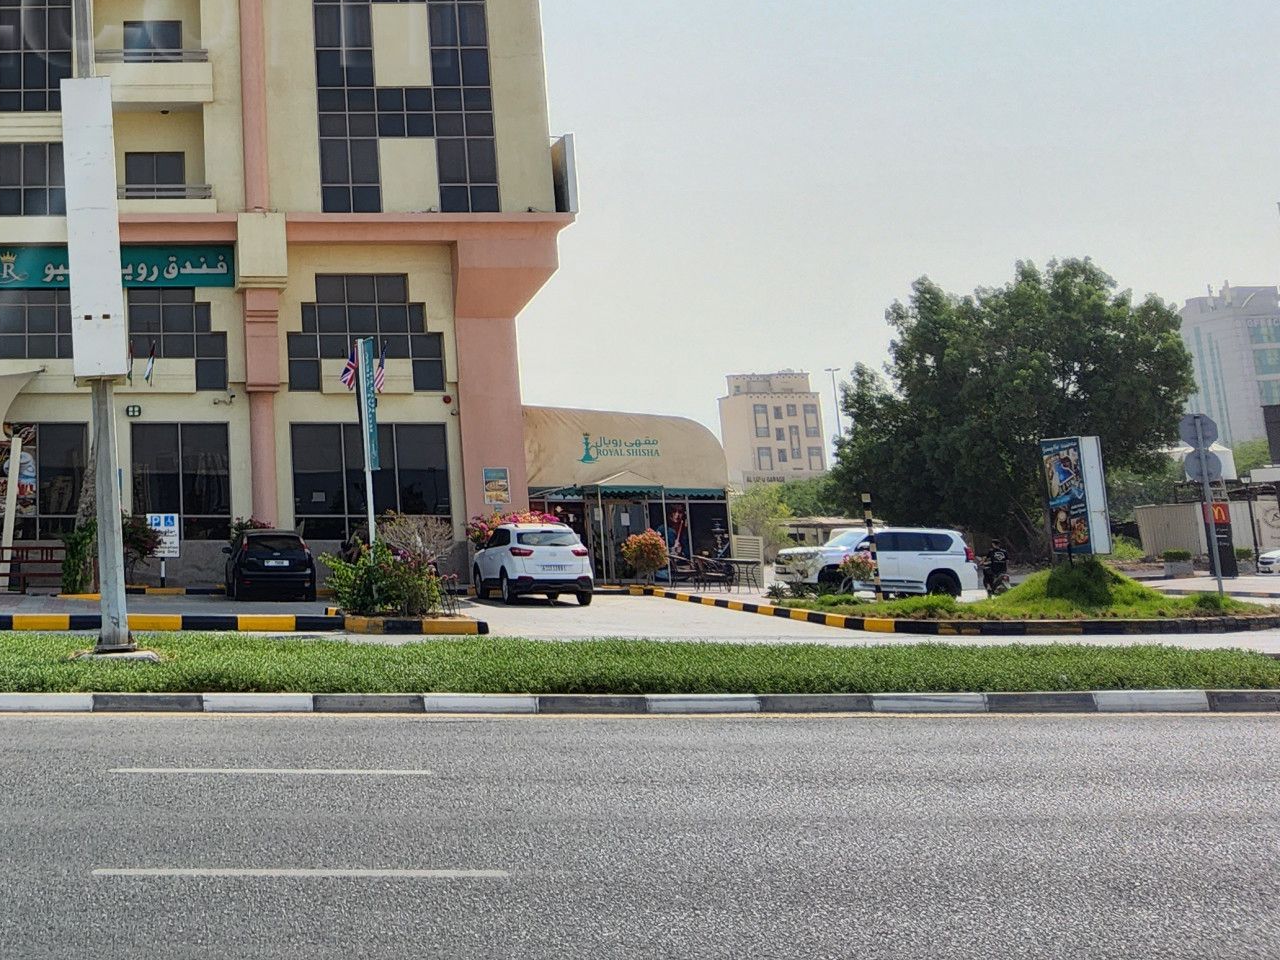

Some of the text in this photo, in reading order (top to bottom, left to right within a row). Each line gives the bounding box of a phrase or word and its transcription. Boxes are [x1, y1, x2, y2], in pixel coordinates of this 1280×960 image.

[163, 255, 228, 279] فندق
[597, 448, 661, 457] ROYAL SHISHA
